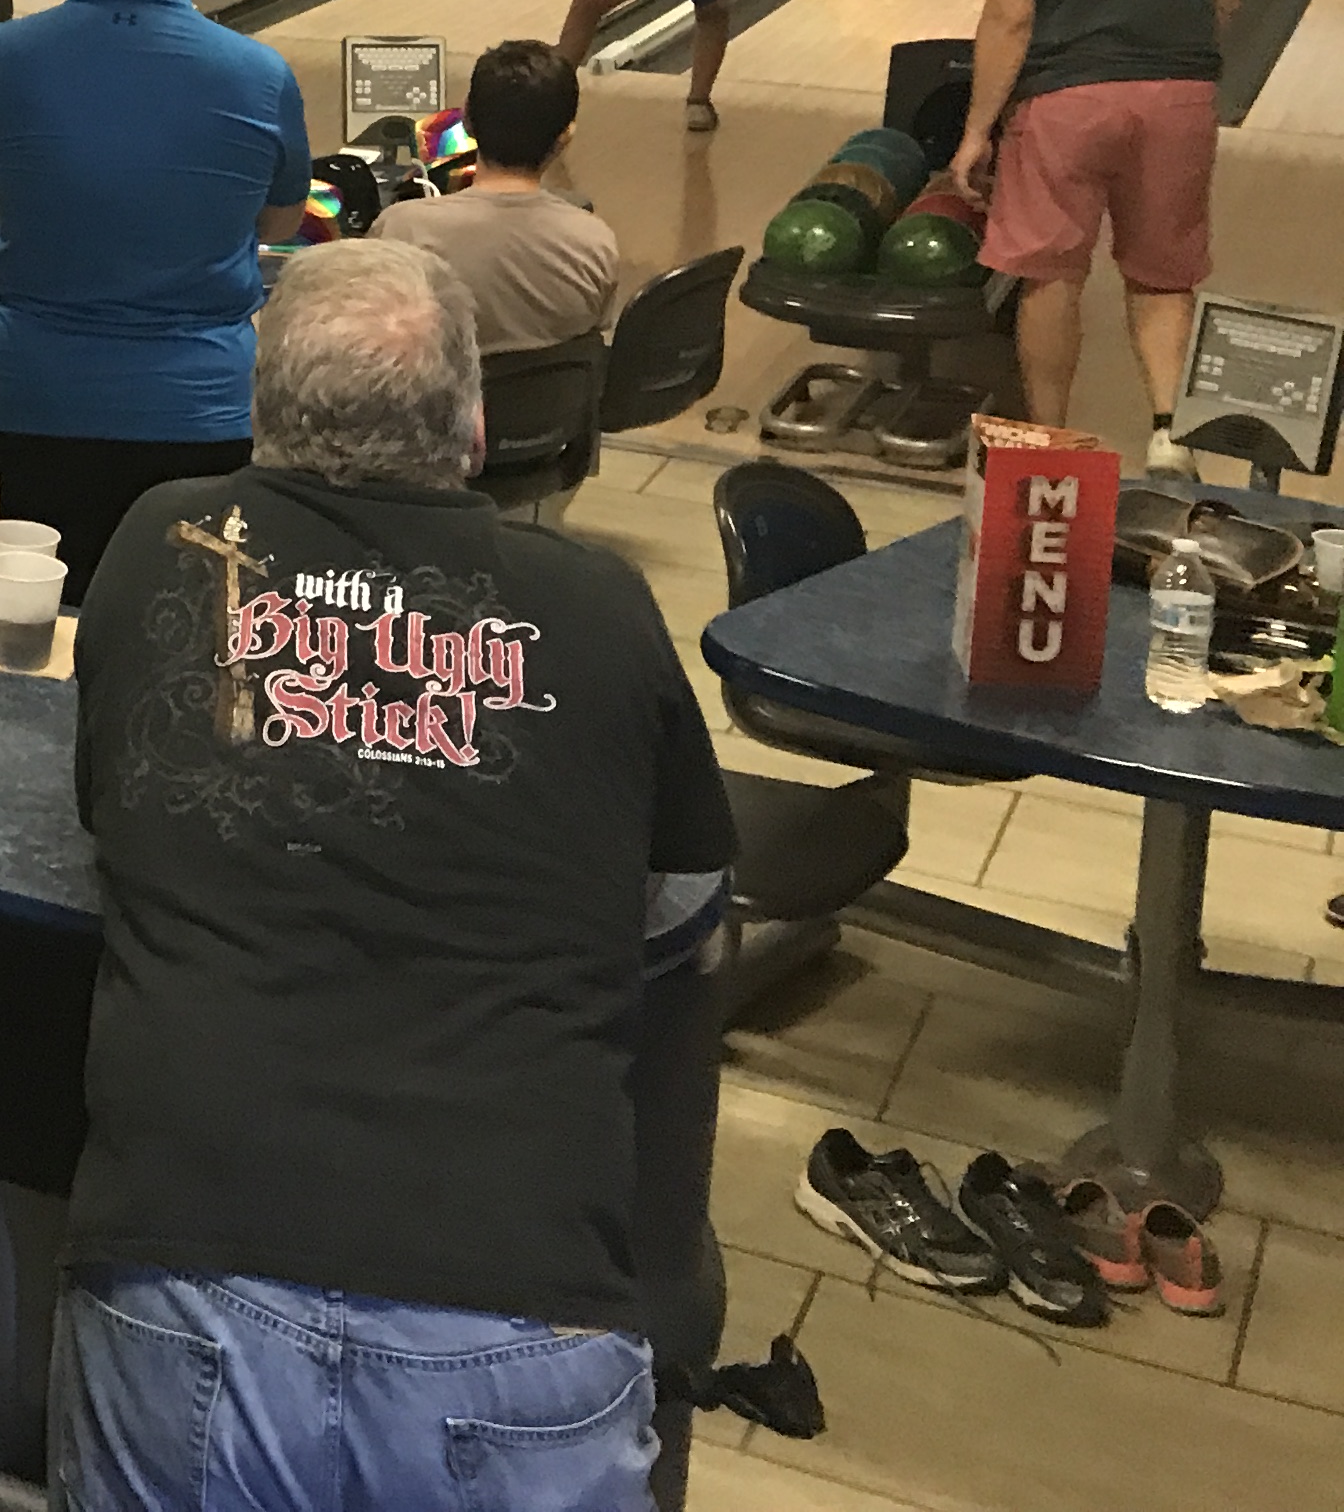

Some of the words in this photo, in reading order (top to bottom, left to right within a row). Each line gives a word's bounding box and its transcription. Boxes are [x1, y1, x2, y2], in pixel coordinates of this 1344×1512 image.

[296, 569, 378, 612] with
[384, 580, 404, 614] a
[1018, 474, 1079, 663] MENU
[214, 591, 350, 691] Big
[355, 611, 556, 712] Ugly
[263, 669, 480, 767] Stick!
[358, 749, 413, 764] COLOSSIANS
